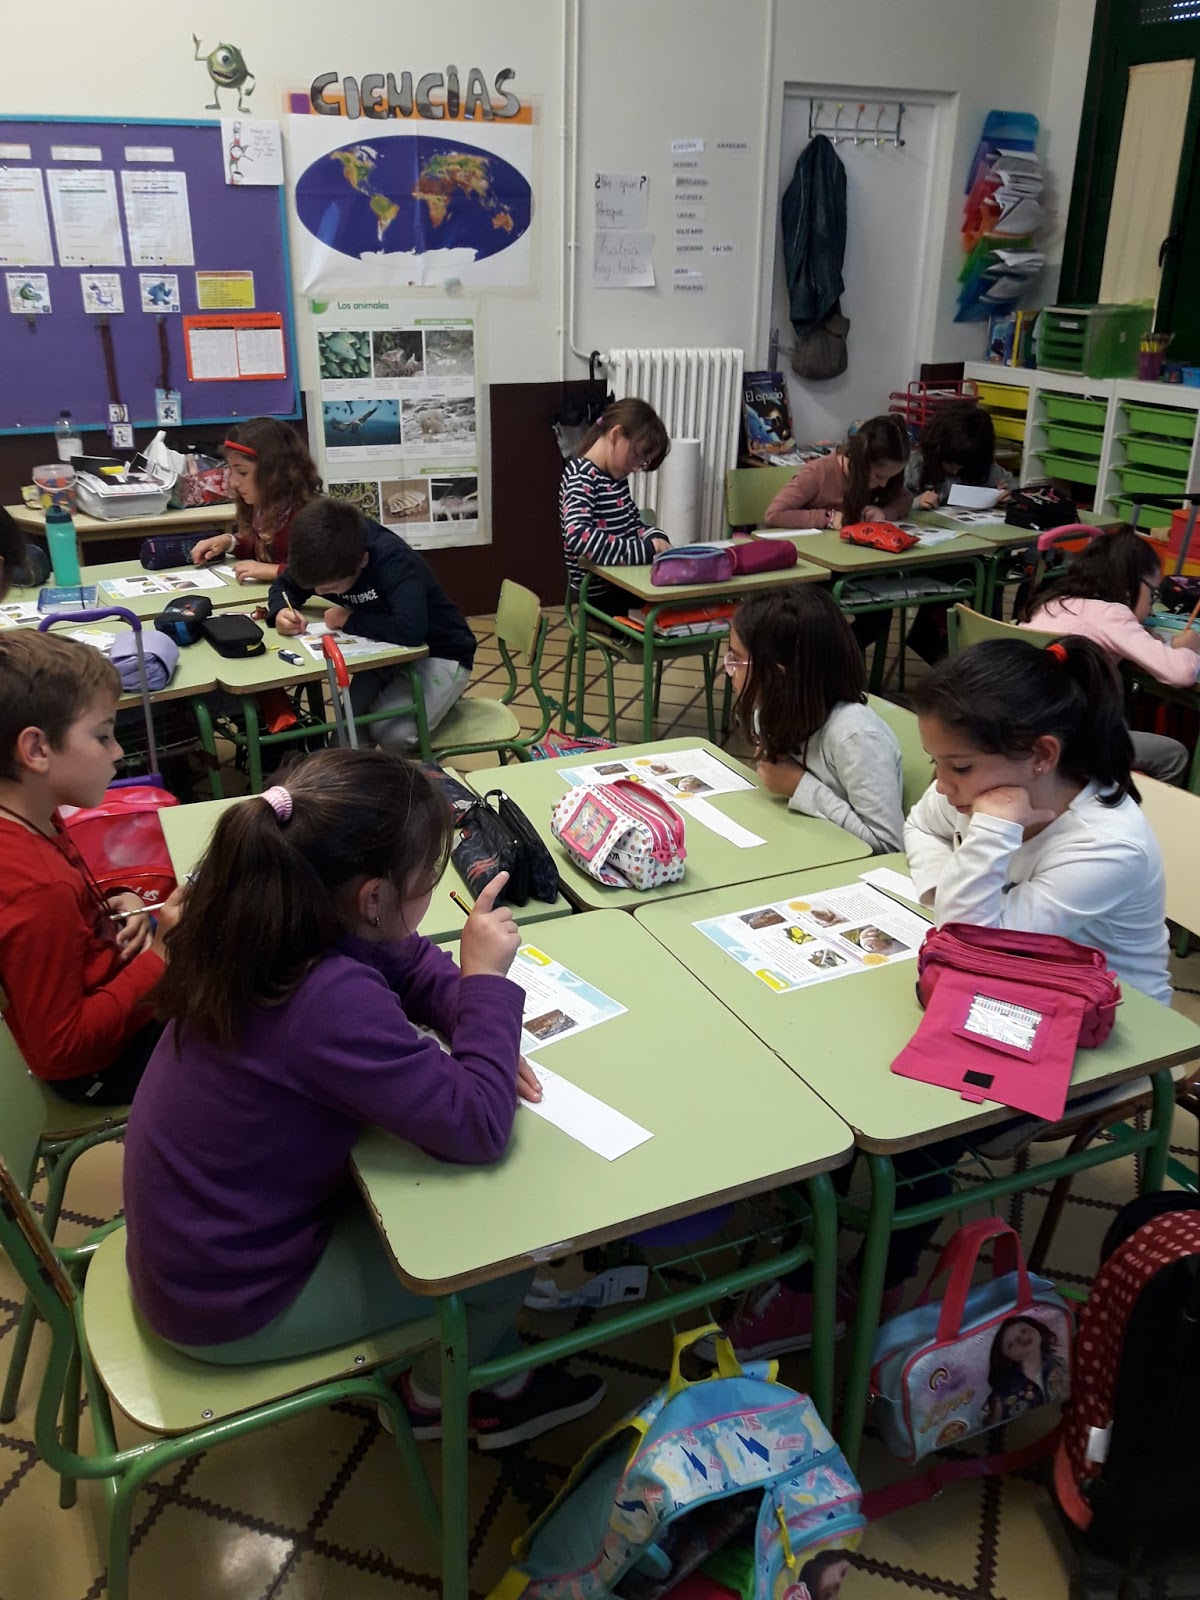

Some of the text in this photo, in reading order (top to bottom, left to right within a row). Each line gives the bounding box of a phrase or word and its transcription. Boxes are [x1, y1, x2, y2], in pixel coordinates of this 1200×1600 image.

[310, 65, 521, 120] CIENCIAS
[338, 301, 390, 310] Los animales
[745, 388, 783, 404] El espacio
[357, 588, 379, 603] SPACE
